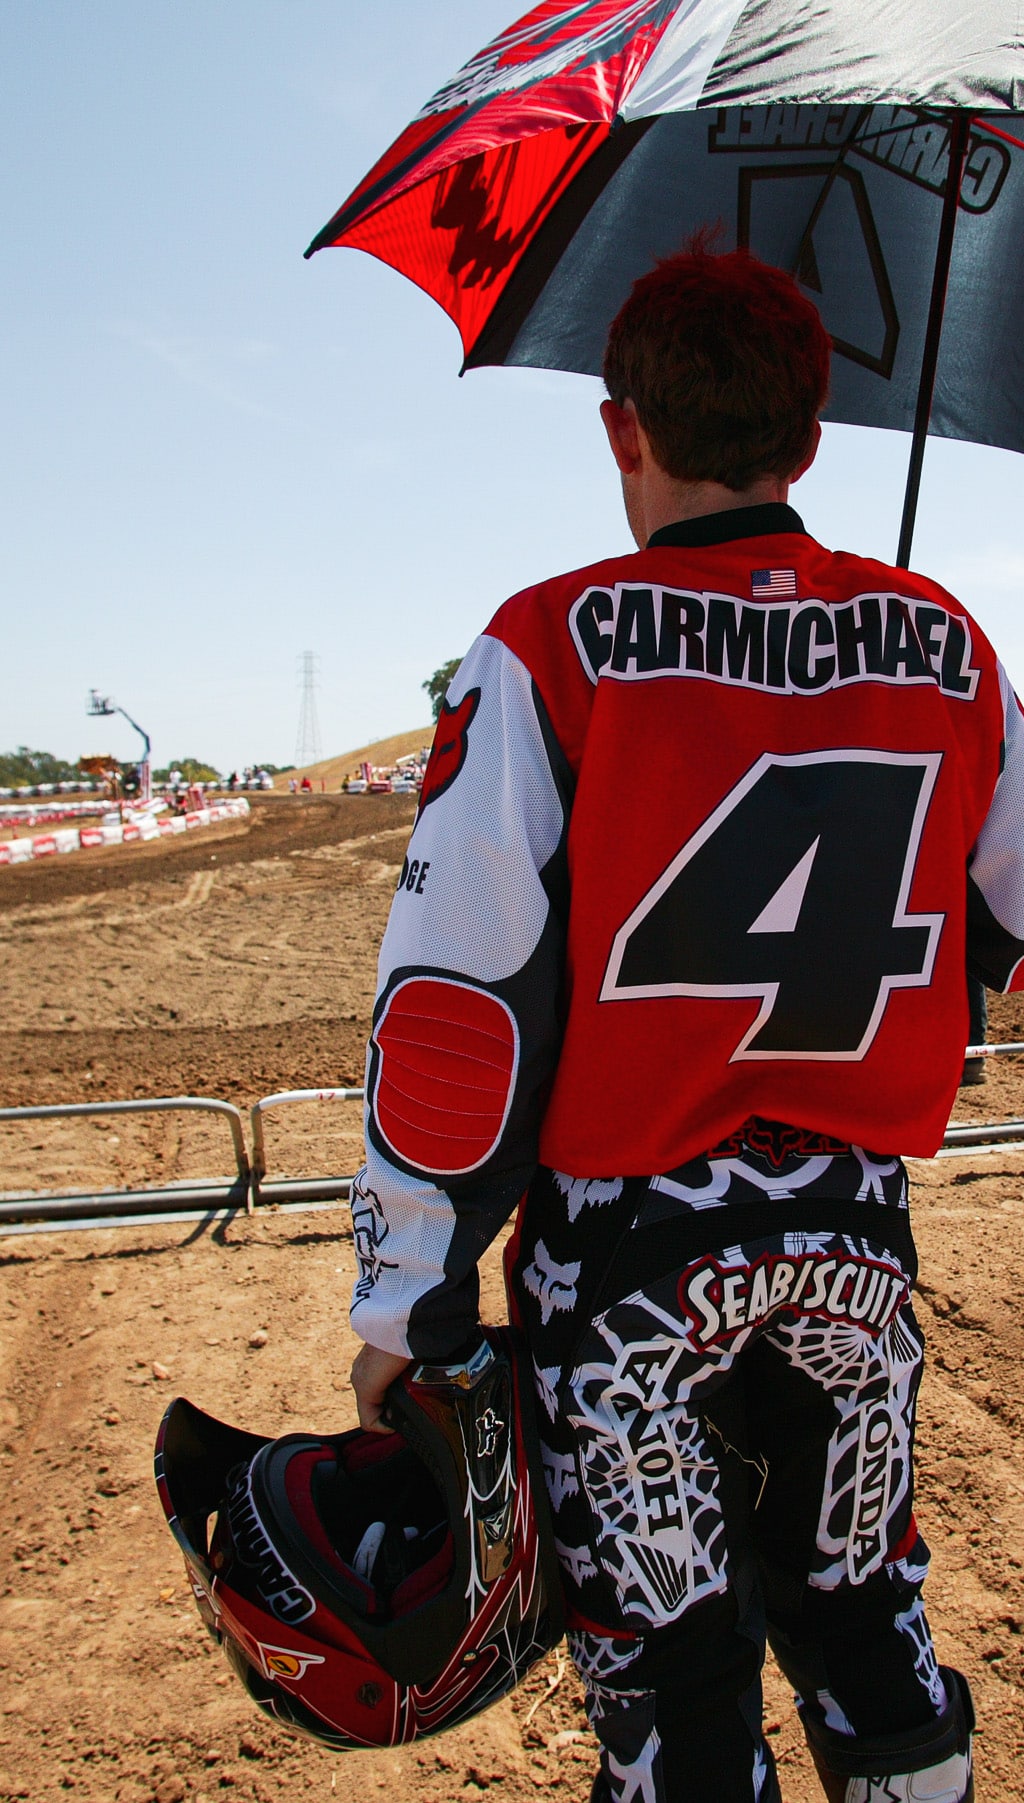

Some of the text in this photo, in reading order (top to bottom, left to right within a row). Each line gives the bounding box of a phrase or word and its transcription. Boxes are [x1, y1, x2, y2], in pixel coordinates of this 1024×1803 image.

[570, 584, 980, 701] CARMICHAEL
[599, 748, 947, 1064] 4
[686, 1257, 907, 1344] SEABISCUIT
